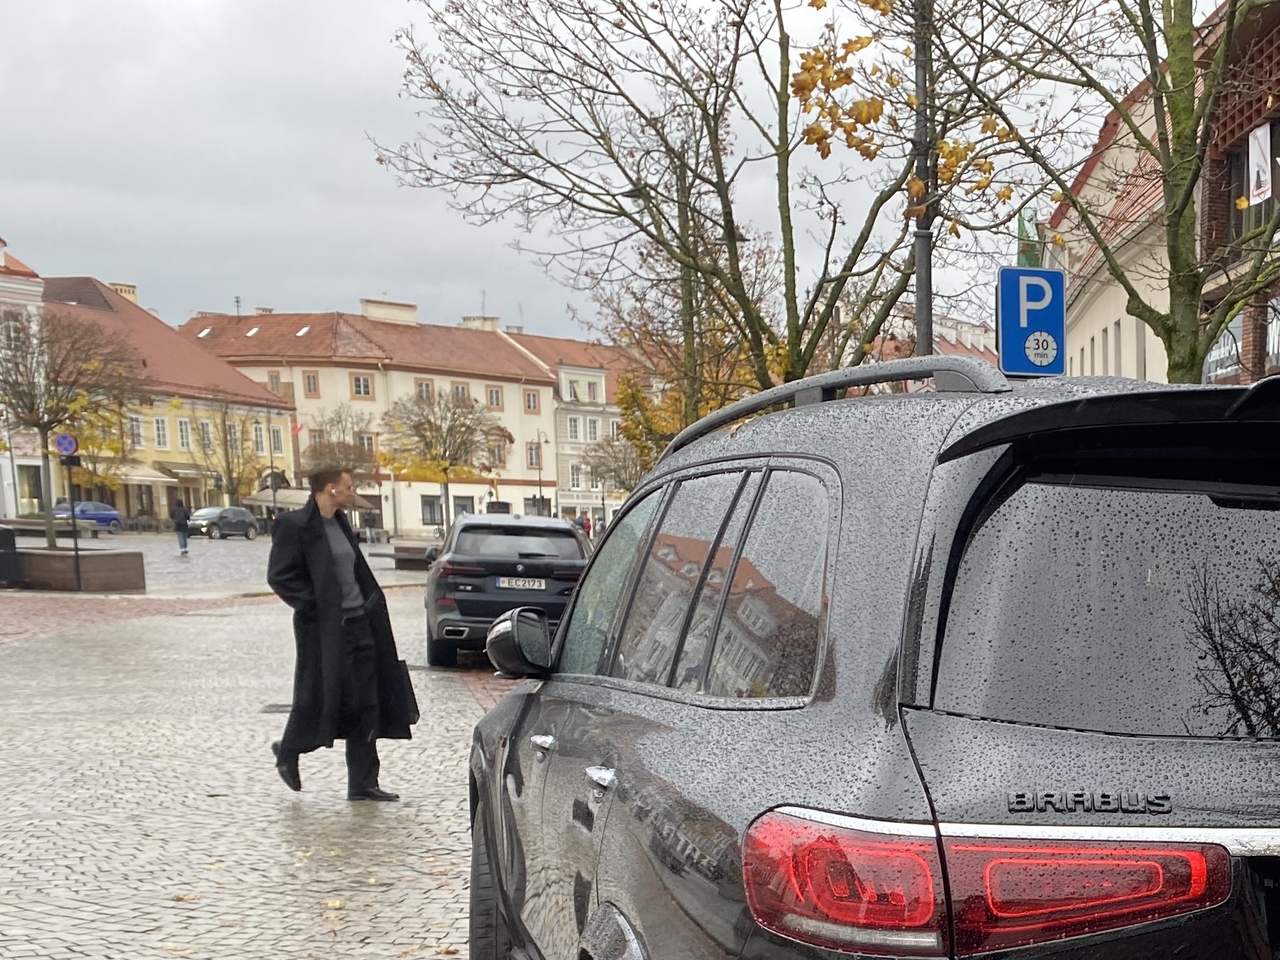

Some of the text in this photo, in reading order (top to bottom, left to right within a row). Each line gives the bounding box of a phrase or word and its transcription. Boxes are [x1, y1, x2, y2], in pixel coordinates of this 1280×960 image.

[1019, 276, 1053, 328] P
[1033, 338, 1049, 350] 30
[1034, 351, 1048, 359] min
[507, 579, 542, 588] EC2173
[1008, 791, 1173, 814] BRABUS
